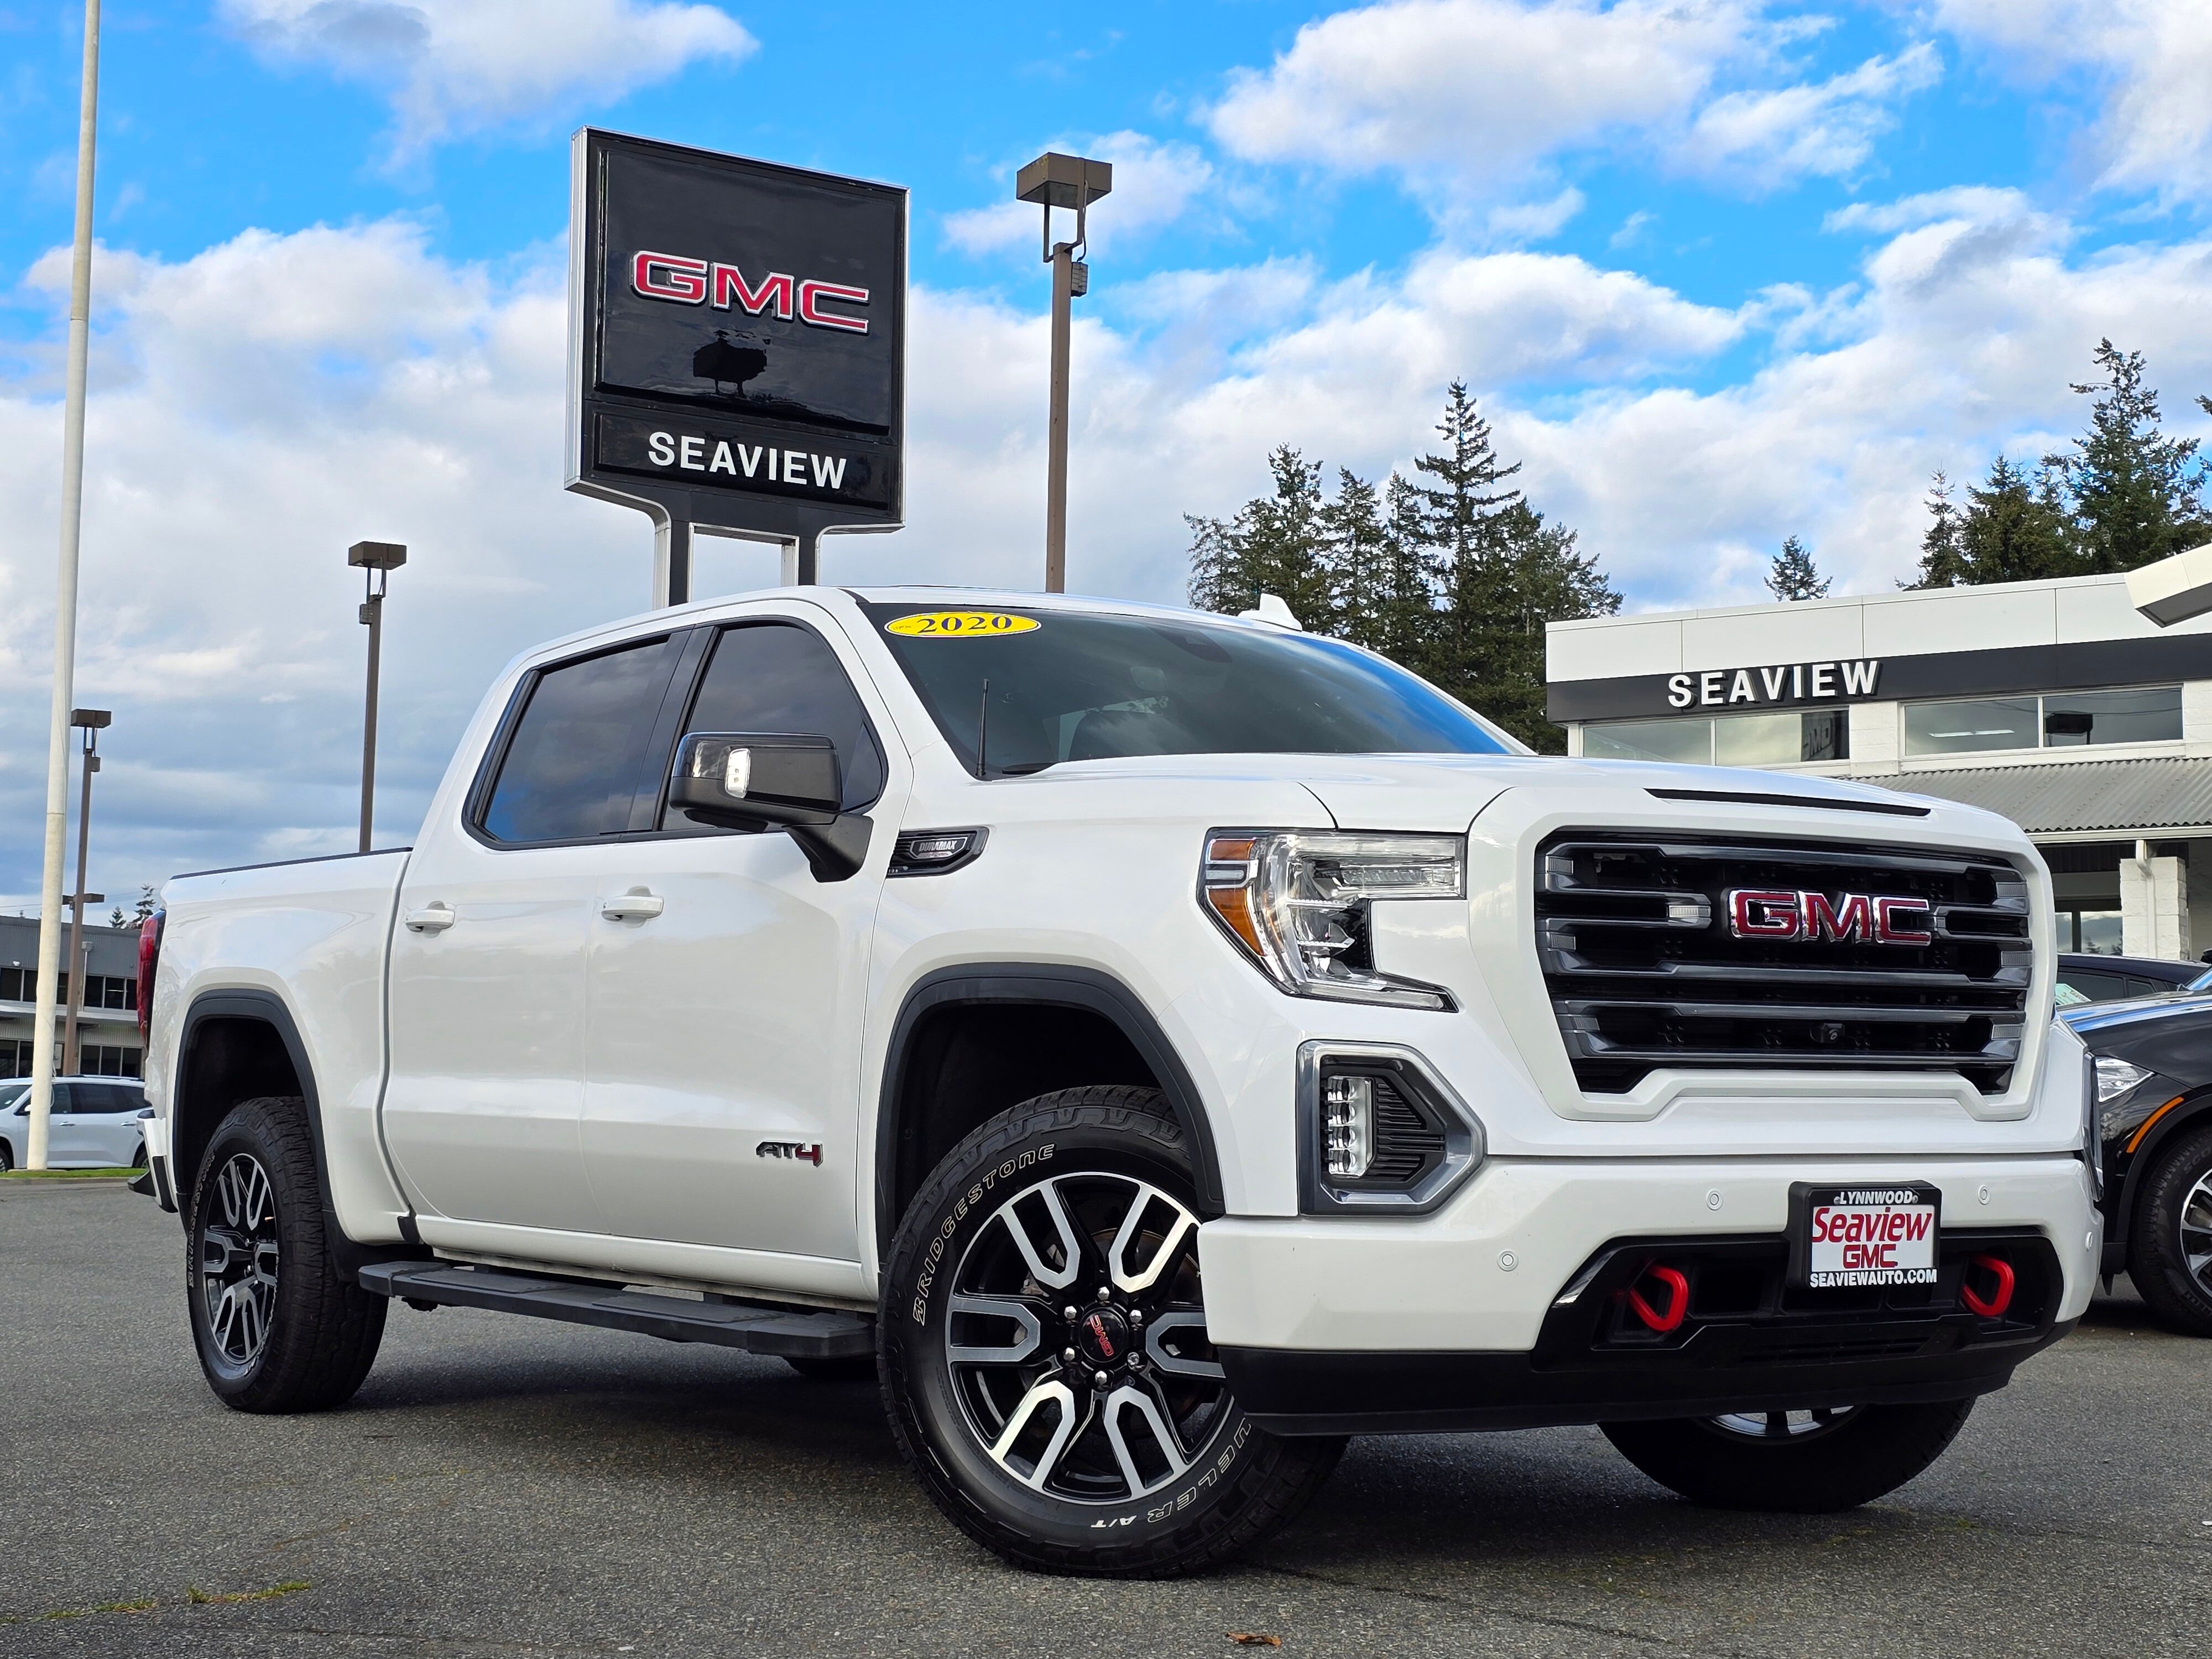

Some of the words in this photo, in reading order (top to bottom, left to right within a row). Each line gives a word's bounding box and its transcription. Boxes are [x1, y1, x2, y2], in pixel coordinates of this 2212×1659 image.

[631, 250, 869, 333] GMC
[648, 431, 847, 489] SEAVIEW
[916, 616, 1012, 634] 2020
[1668, 660, 1879, 708] SEAVIEW
[919, 840, 958, 852] DURAMAX
[1729, 890, 1932, 946] GMC
[756, 1141, 824, 1168] AT4
[1839, 1191, 1913, 1205] LYNNWOOD
[912, 1143, 1055, 1327] BRIDGESTONE
[1811, 1207, 1933, 1243] Seaview
[1843, 1244, 1897, 1269] GMC
[1809, 1269, 1938, 1288] SEAVIEWAUTO.COM
[1089, 1314, 1114, 1357] GMC
[1090, 1515, 1137, 1528] A/T
